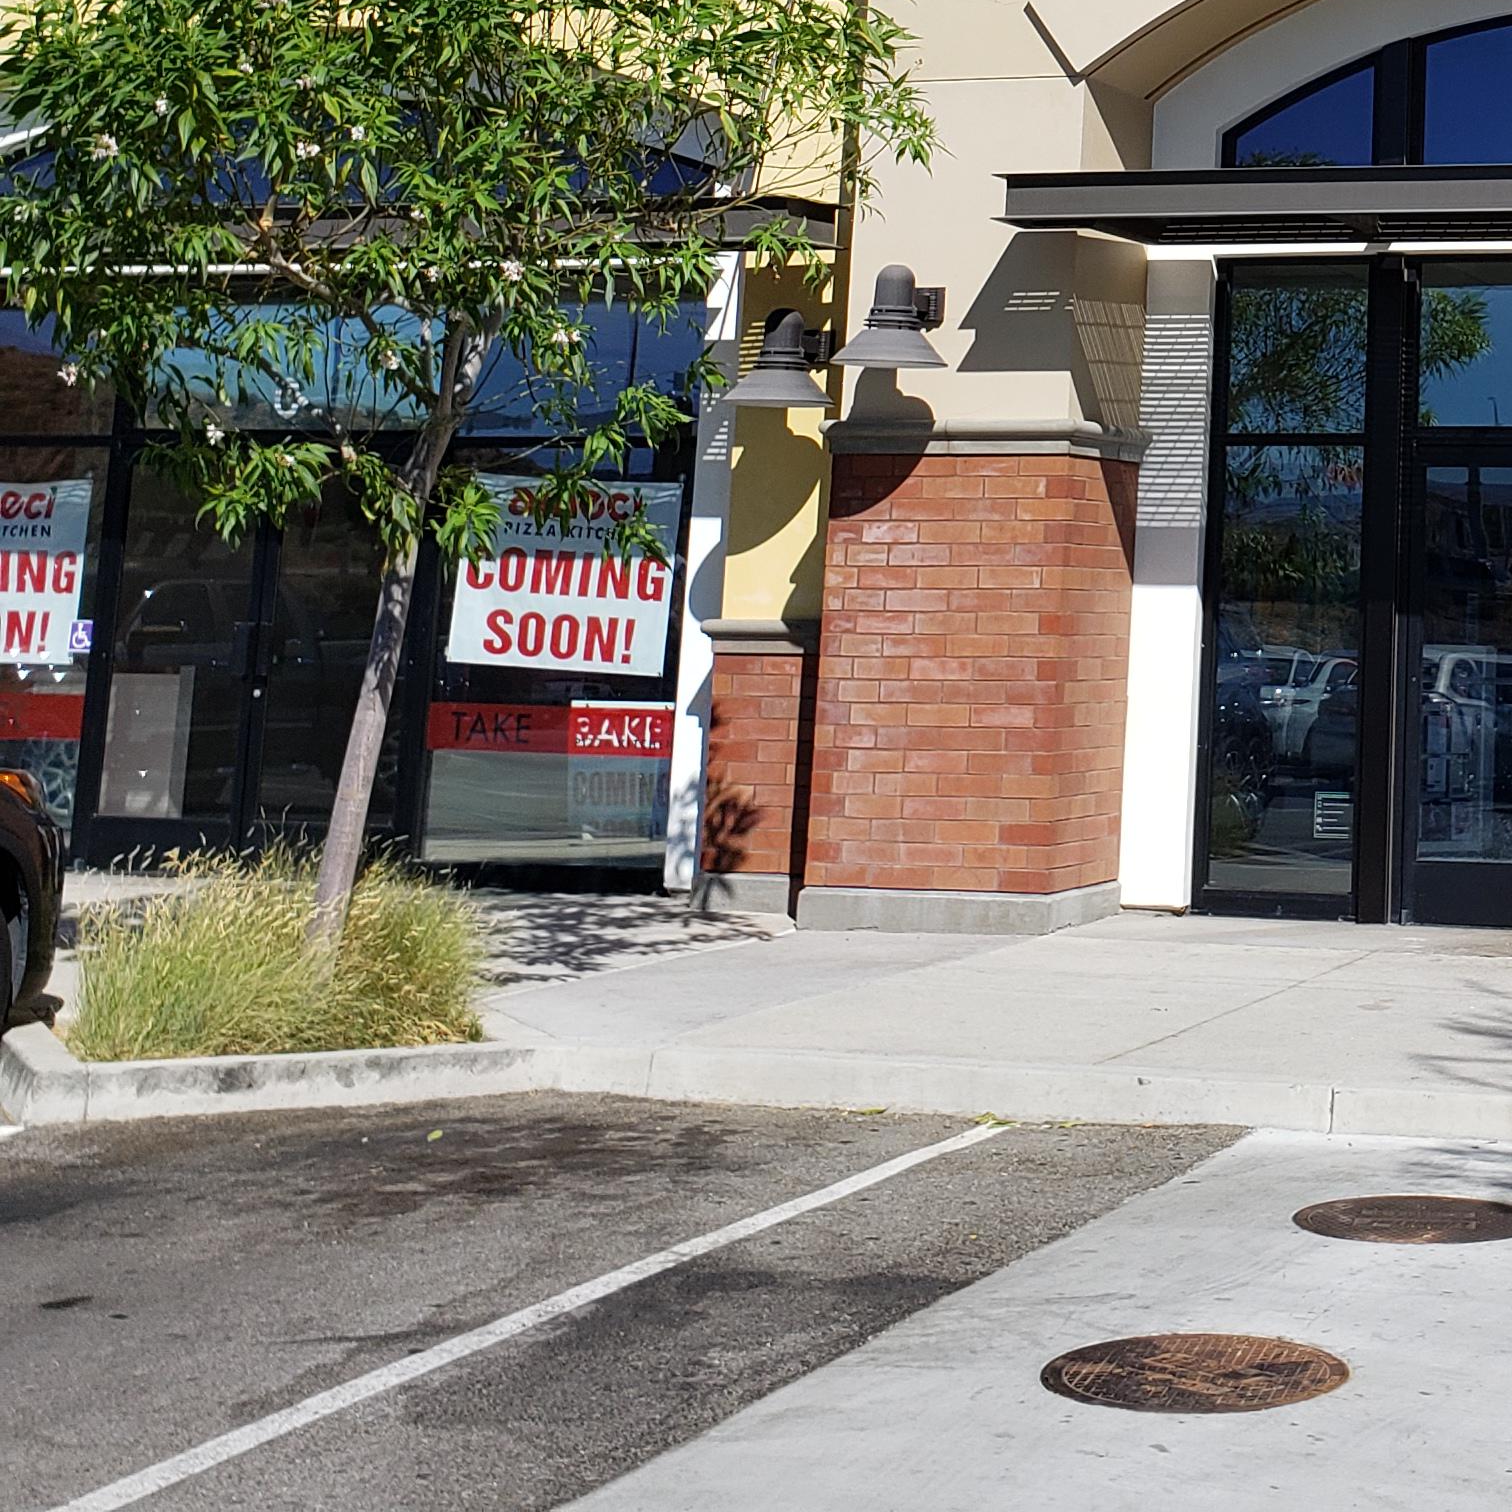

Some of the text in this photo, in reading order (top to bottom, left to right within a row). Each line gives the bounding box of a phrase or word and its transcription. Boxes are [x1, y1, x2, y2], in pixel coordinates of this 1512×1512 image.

[466, 547, 666, 602] COMING
[483, 609, 636, 664] SOON!
[452, 712, 662, 750] TAKE BAKE
